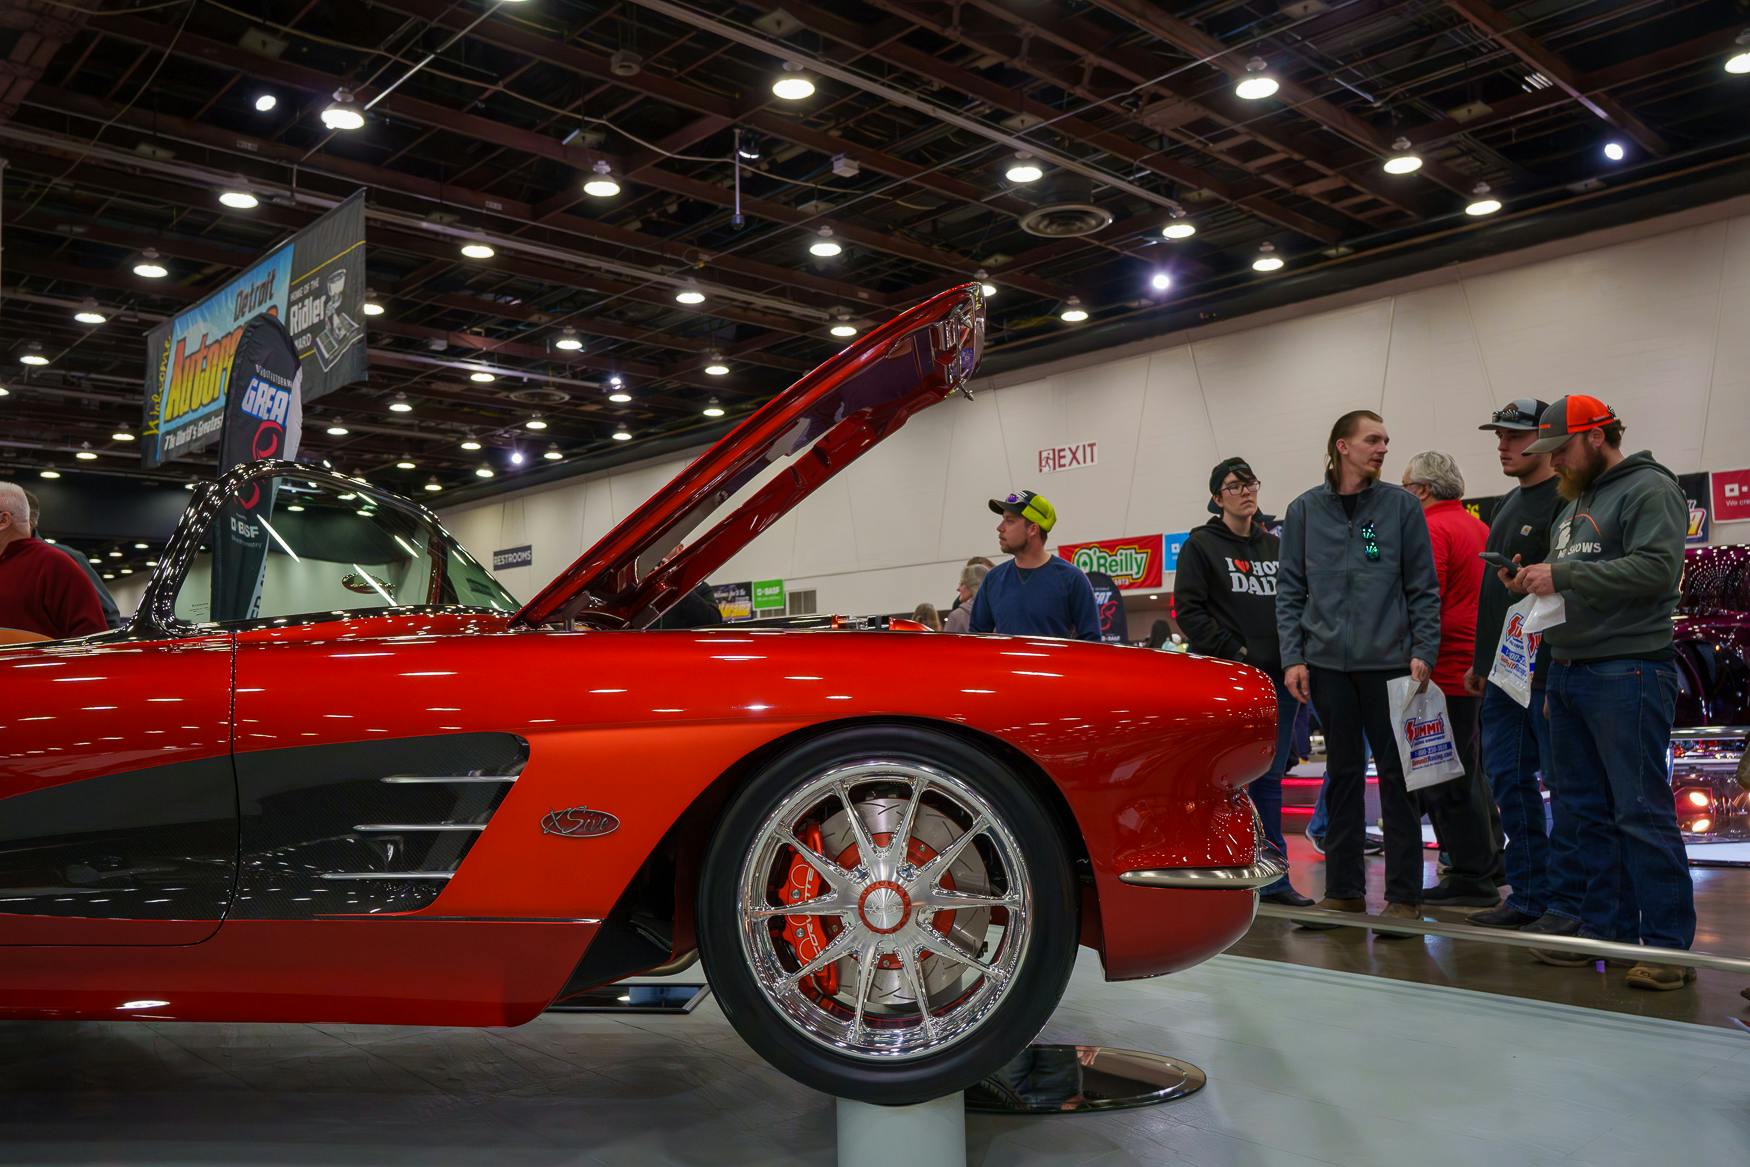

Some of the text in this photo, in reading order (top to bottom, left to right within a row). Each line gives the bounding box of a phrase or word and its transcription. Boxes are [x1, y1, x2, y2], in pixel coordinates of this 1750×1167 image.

[234, 268, 276, 322] Detroit
[290, 295, 326, 337] Ridler
[241, 377, 291, 426] GREA
[1057, 443, 1096, 468] EXIT
[495, 551, 531, 565] RESTROOMS
[1075, 549, 1145, 577] O'Reilly
[1225, 557, 1236, 571] I
[805, 867, 821, 956] CORVTTE
